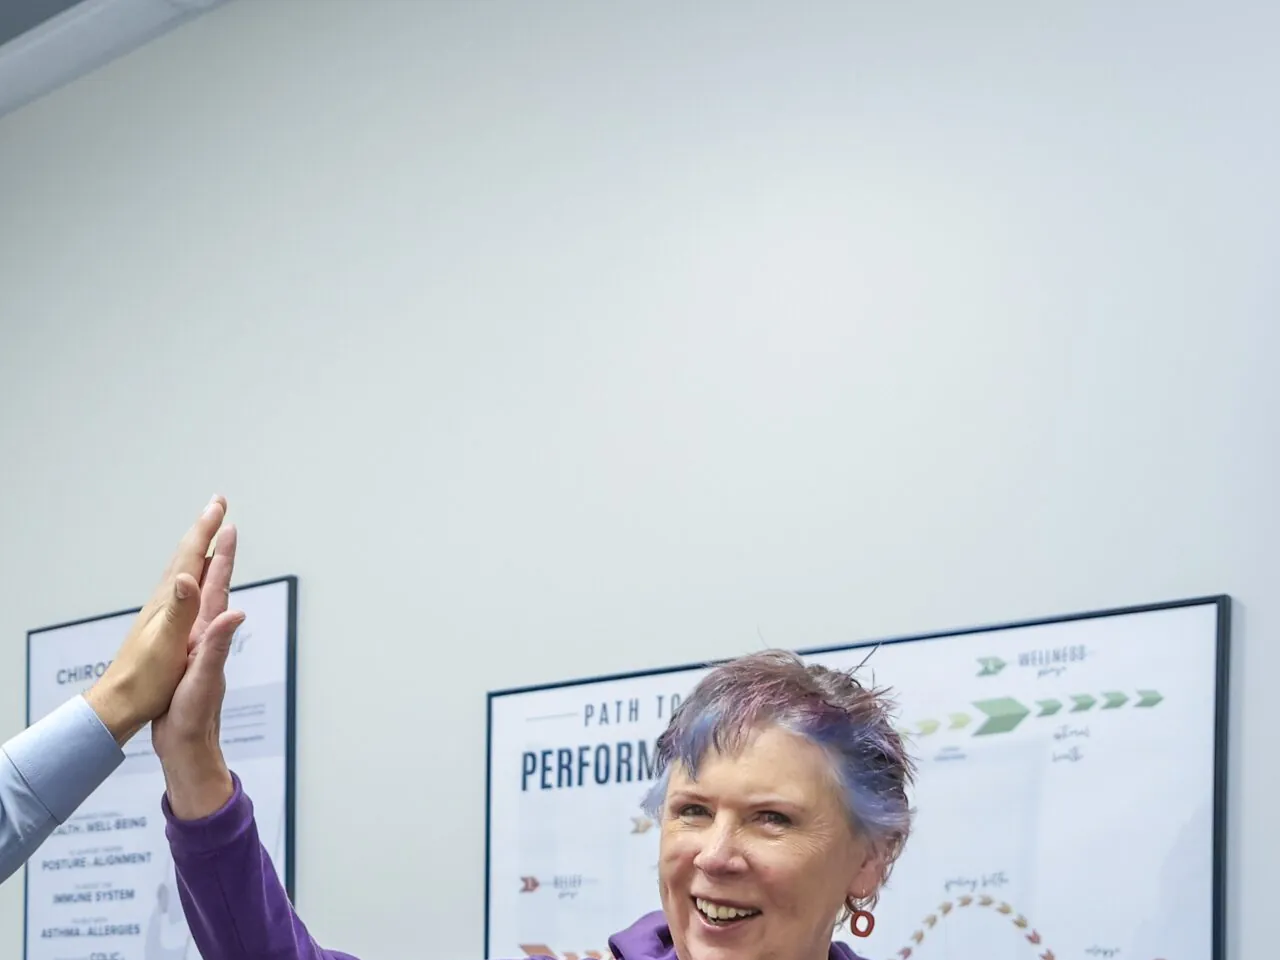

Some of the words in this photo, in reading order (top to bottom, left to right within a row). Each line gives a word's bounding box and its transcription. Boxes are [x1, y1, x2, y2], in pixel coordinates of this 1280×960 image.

[584, 698, 639, 727] PATH
[657, 693, 681, 719] TO
[86, 816, 148, 832] WELL-BEING
[42, 857, 86, 870] POSTURE
[93, 851, 151, 866] ALIGNMENT
[53, 891, 92, 903] IMMUNE
[95, 889, 135, 902] SYSTEM
[40, 927, 80, 938] ASTHMA
[87, 923, 140, 937] ALLERGIES
